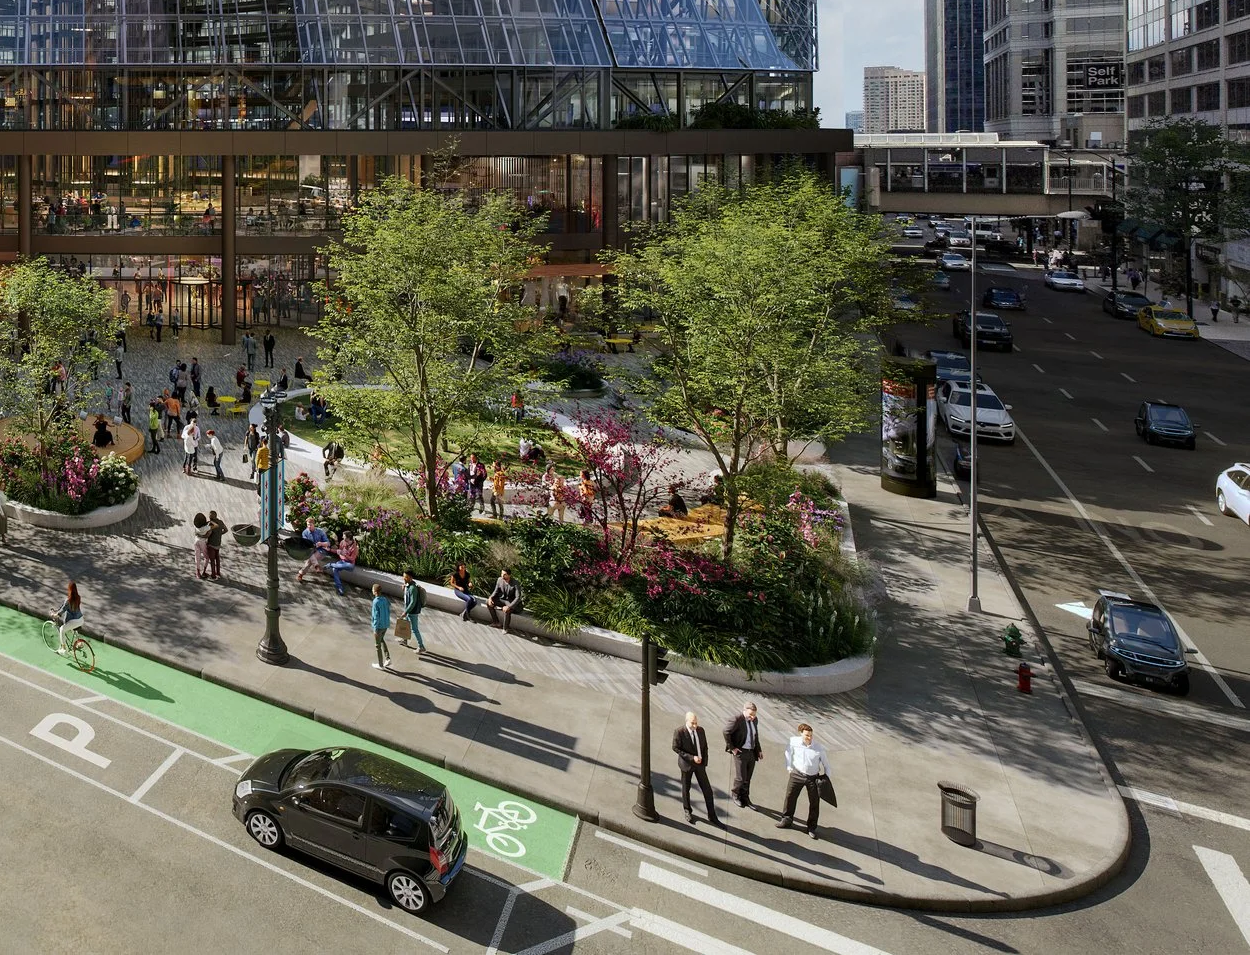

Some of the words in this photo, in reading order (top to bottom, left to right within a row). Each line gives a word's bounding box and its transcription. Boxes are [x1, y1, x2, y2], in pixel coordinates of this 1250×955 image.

[1087, 66, 1115, 76] Self
[1088, 76, 1119, 85] Park
[29, 712, 112, 769] P
